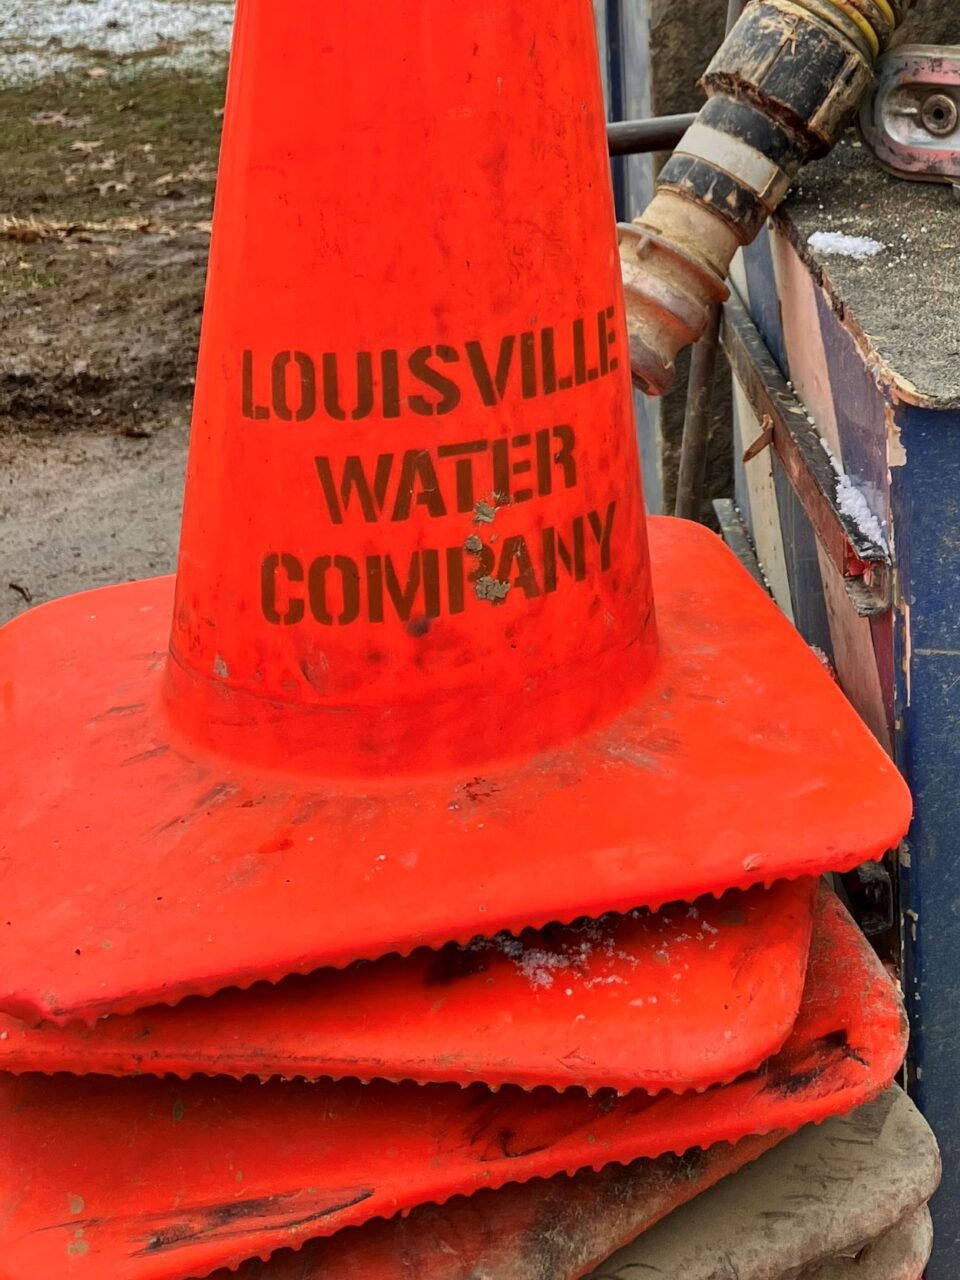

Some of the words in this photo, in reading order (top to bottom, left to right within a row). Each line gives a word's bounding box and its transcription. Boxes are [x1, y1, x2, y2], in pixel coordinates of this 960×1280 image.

[241, 306, 619, 422] LOUISVILLE
[314, 424, 577, 524] WATER
[260, 500, 617, 626] COMPANY
